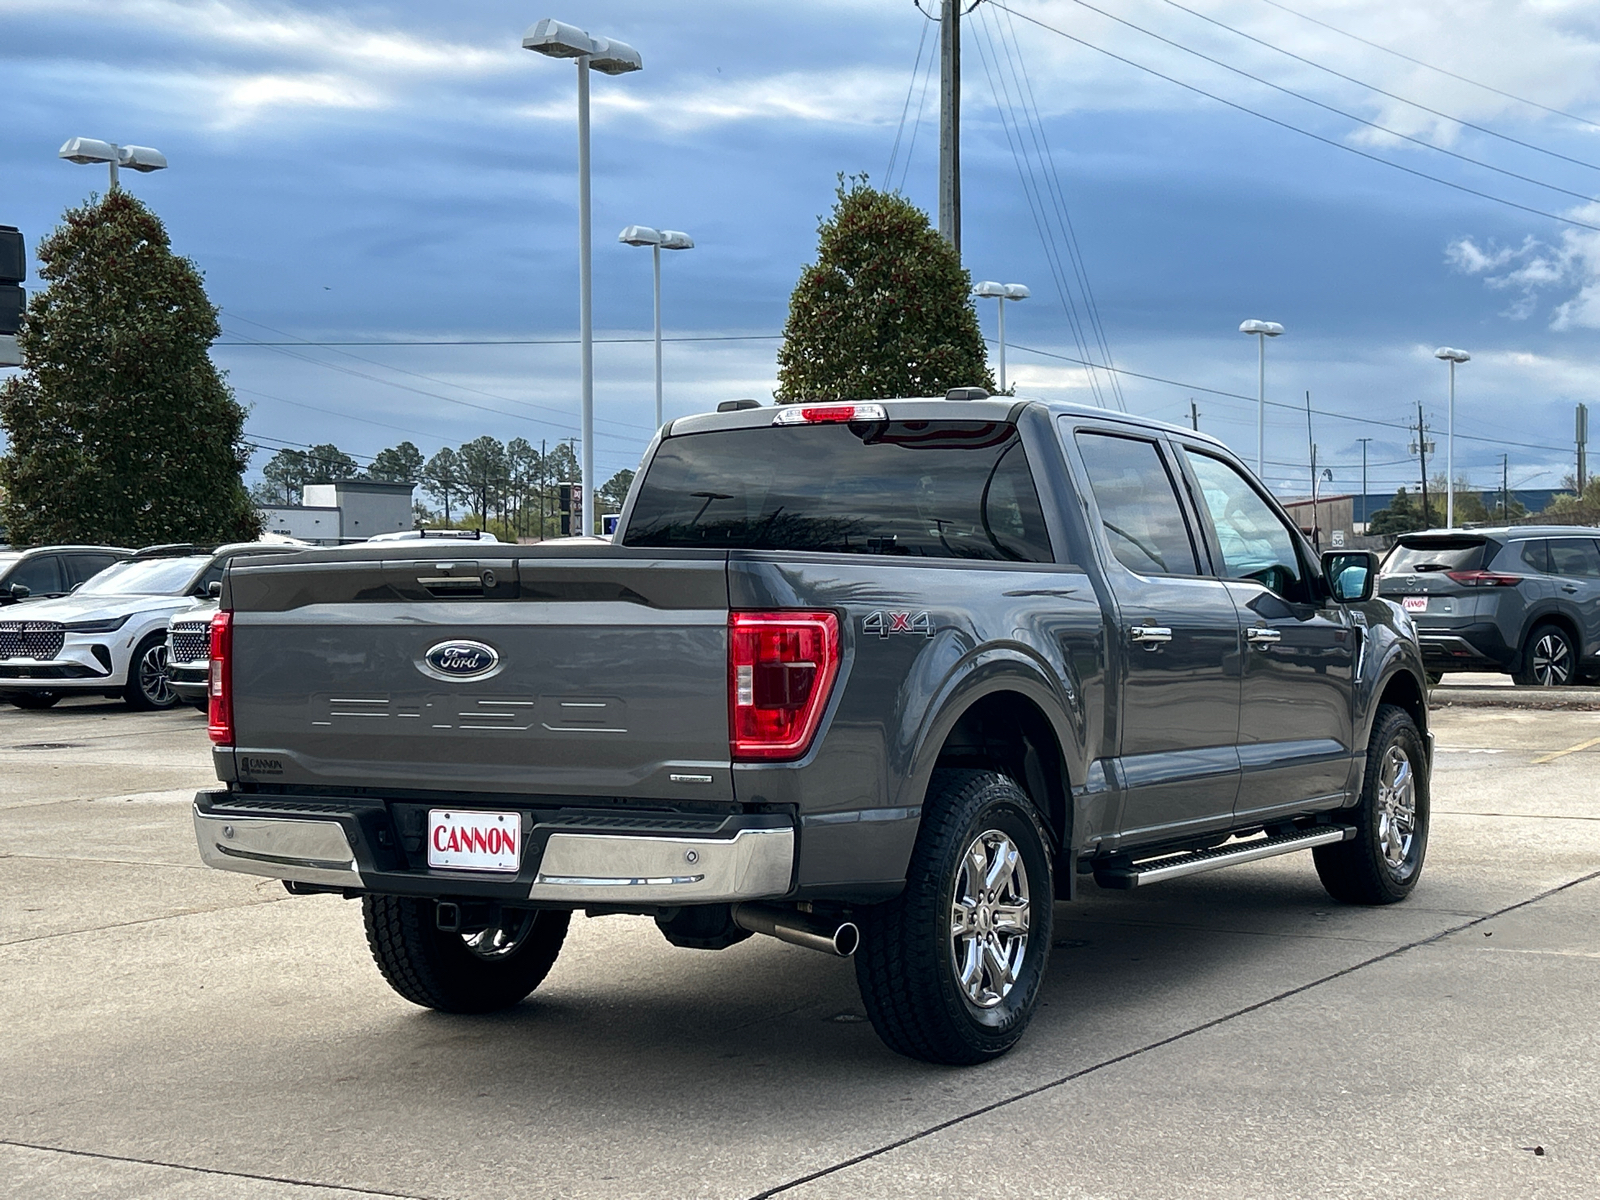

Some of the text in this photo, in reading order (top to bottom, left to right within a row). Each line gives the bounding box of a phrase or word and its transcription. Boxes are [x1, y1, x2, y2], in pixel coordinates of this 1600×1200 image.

[440, 647, 480, 668] Ford
[311, 691, 628, 733] F-150
[250, 758, 283, 769] CANNON
[433, 825, 516, 855] CANNON
